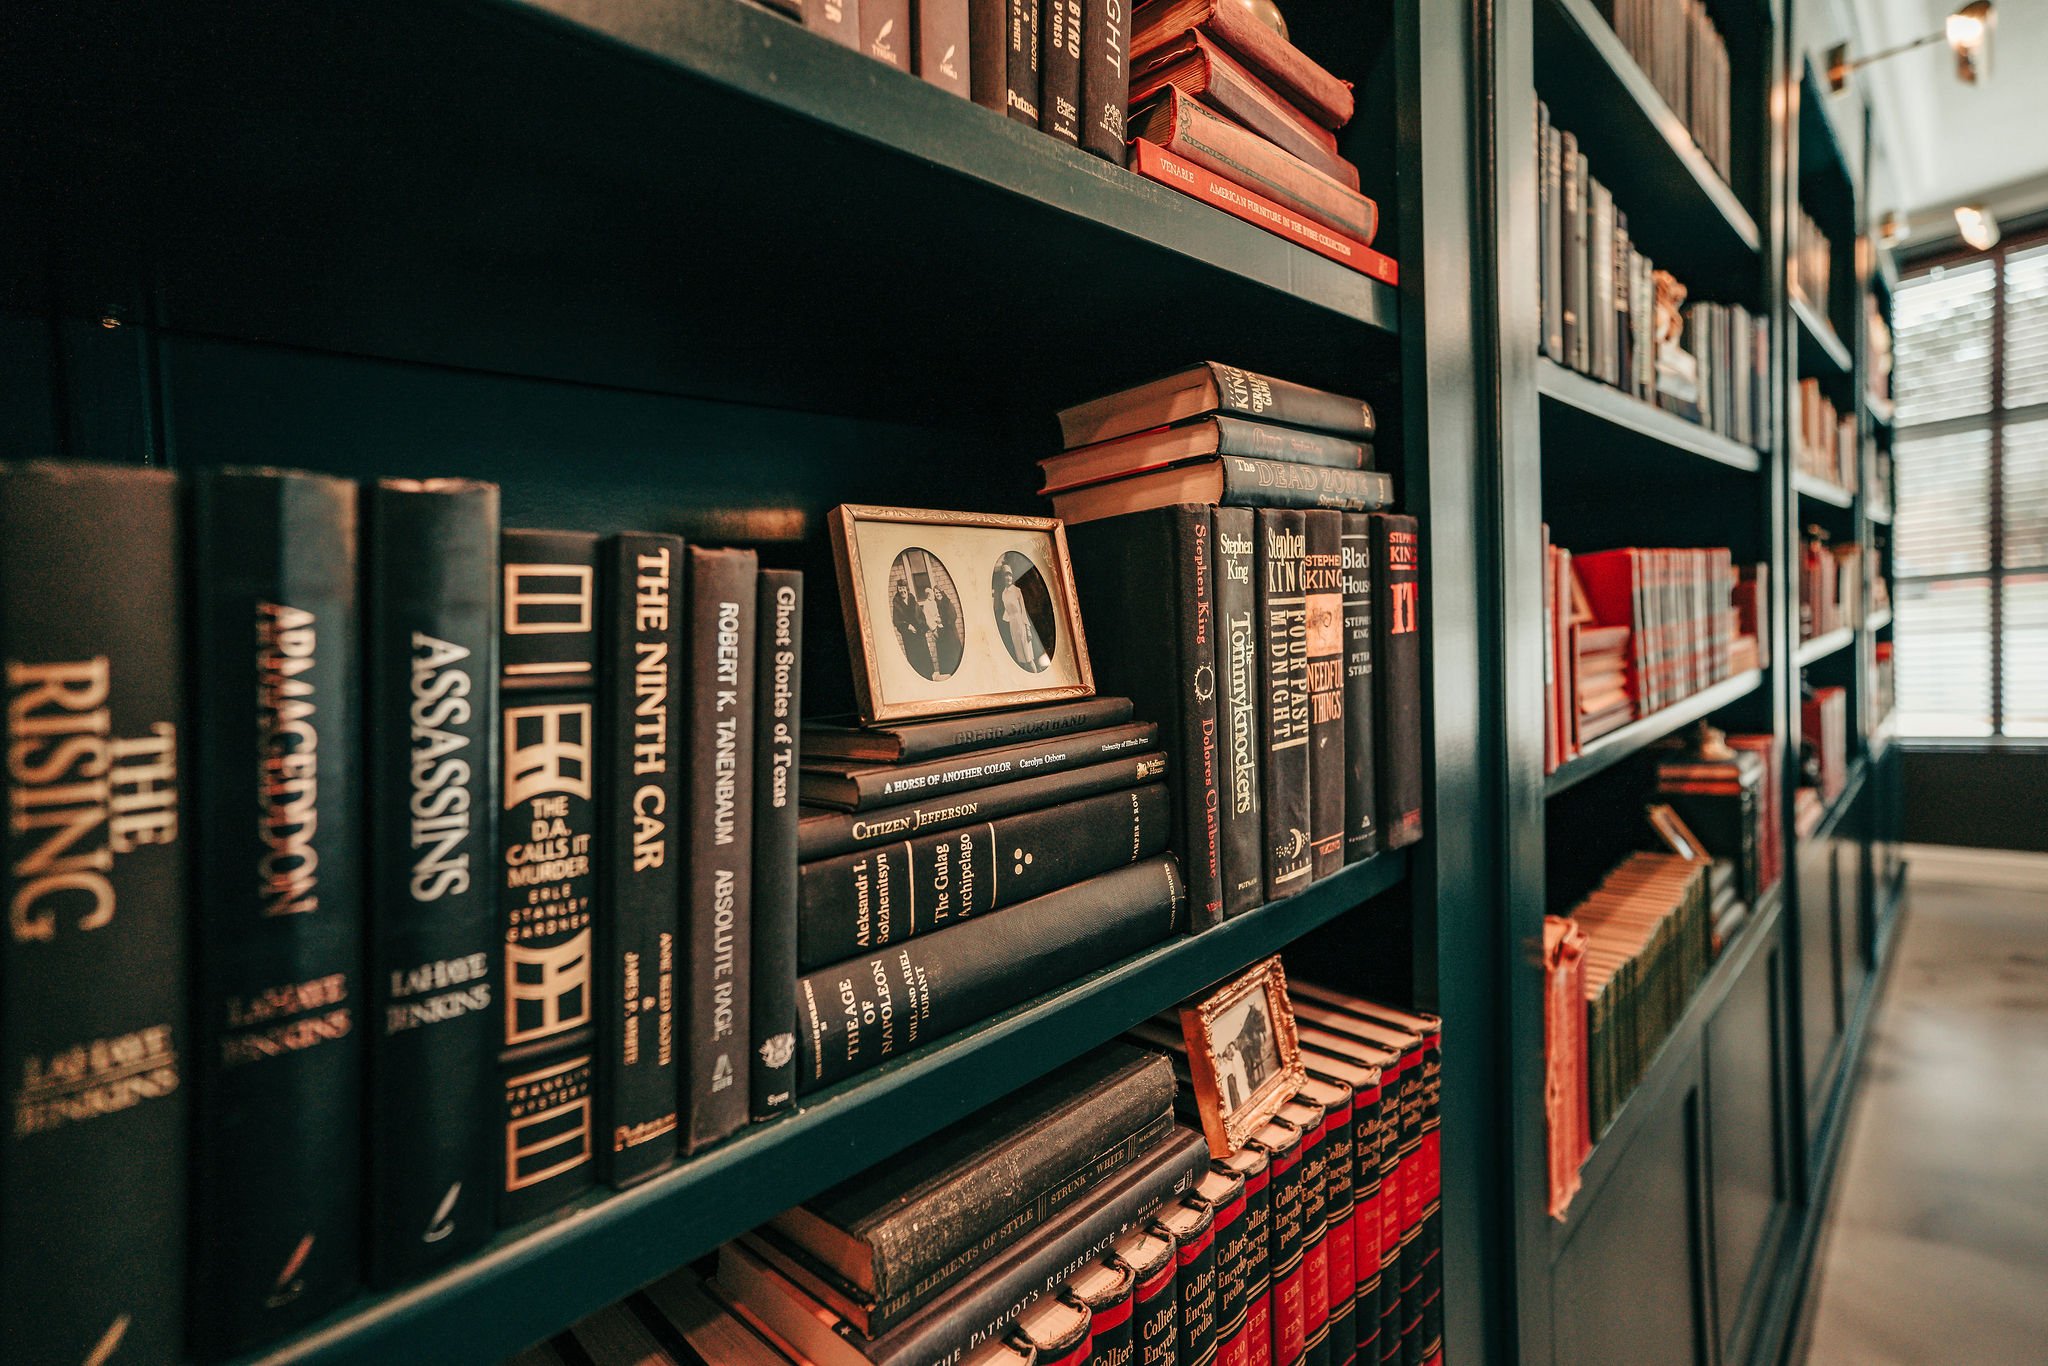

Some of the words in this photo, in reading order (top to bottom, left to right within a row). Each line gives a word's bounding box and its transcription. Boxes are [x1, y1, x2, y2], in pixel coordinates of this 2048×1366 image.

[1053, 1, 1063, 48] D'ORSO
[1068, 0, 1081, 59] BYRD
[1008, 89, 1038, 121] Putnam
[1160, 158, 1195, 183] VENABLE
[1209, 181, 1247, 208] AMERICAN
[1247, 199, 1282, 225] FURNITURE
[1282, 215, 1290, 228] IN
[1290, 219, 1303, 235] THE
[1318, 232, 1351, 257] COLLECTION
[1231, 367, 1249, 410] KING
[1235, 459, 1256, 473] The
[1255, 461, 1317, 491] DEAD
[1320, 469, 1368, 495] ZONE
[1221, 532, 1253, 559] Stephen
[1268, 527, 1306, 566] Stephen
[1389, 532, 1417, 544] STEPH
[1194, 524, 1207, 597] Stephen
[1226, 559, 1249, 585] King
[636, 547, 670, 632] THE
[776, 586, 796, 647] Ghost
[1196, 601, 1209, 645] King
[717, 602, 739, 686] ROBERT
[1246, 638, 1254, 665] The
[1288, 610, 1307, 673] FOUR
[774, 651, 795, 718] Stories
[1270, 610, 1290, 737] MIDNIGHT
[1307, 659, 1344, 692] NEEDFUL
[634, 642, 668, 775] NINTH
[716, 690, 737, 712] K.
[1230, 611, 1255, 814] Tommyknockers
[1290, 677, 1308, 735] PAST
[1311, 691, 1341, 724] THINGS
[774, 723, 793, 744] of
[1202, 718, 1214, 786] Dolores
[410, 631, 471, 902] ASSASSINS
[714, 716, 737, 846] TANENBAUM
[773, 749, 792, 808] Texas
[884, 782, 893, 794] A
[894, 776, 926, 792] HORSE
[927, 774, 940, 786] OF
[942, 764, 982, 783] ANOTHER
[983, 762, 1011, 776] COLOR
[1019, 757, 1043, 769] Carolyn
[1044, 753, 1066, 764] Osborn
[7, 655, 117, 941] RISING
[108, 721, 179, 853] THE
[531, 795, 569, 819] THE
[1131, 793, 1140, 814] ROW
[505, 837, 569, 866] CALLS
[572, 834, 592, 854] IT
[633, 784, 667, 872] CAR
[1131, 824, 1140, 861] HARPER
[1205, 789, 1218, 879] Claiborne
[507, 856, 590, 889] MURDER
[934, 843, 949, 890] Gulag
[959, 833, 975, 917] Archipelago
[856, 876, 870, 947] Aleksandr
[876, 852, 889, 945] Solzhenitsyn
[934, 894, 949, 923] The
[713, 869, 735, 981] ABSOLUTE
[900, 950, 914, 982] ARIEL
[839, 978, 857, 1017] AGE
[862, 1000, 878, 1025] OF
[871, 959, 893, 1055] NAPOLEON
[908, 982, 918, 1010] AND
[915, 966, 929, 1019] DURANT
[845, 1019, 860, 1061] THE
[909, 1011, 918, 1042] WILL
[1051, 1175, 1087, 1204] STRUNK
[1096, 1150, 1125, 1175] WHITE
[882, 1294, 911, 1320] THE
[915, 1247, 980, 1295] ELEMENTS
[982, 1233, 997, 1250] OF
[1000, 1208, 1034, 1240] STYLE
[1185, 1265, 1216, 1302] Collier's
[970, 1288, 1039, 1350] PATRIOT'S
[1046, 1232, 1116, 1291] REFERENCE
[1222, 1278, 1245, 1311] pedia
[1143, 1300, 1178, 1341] Collier's
[1190, 1313, 1213, 1347] pedia
